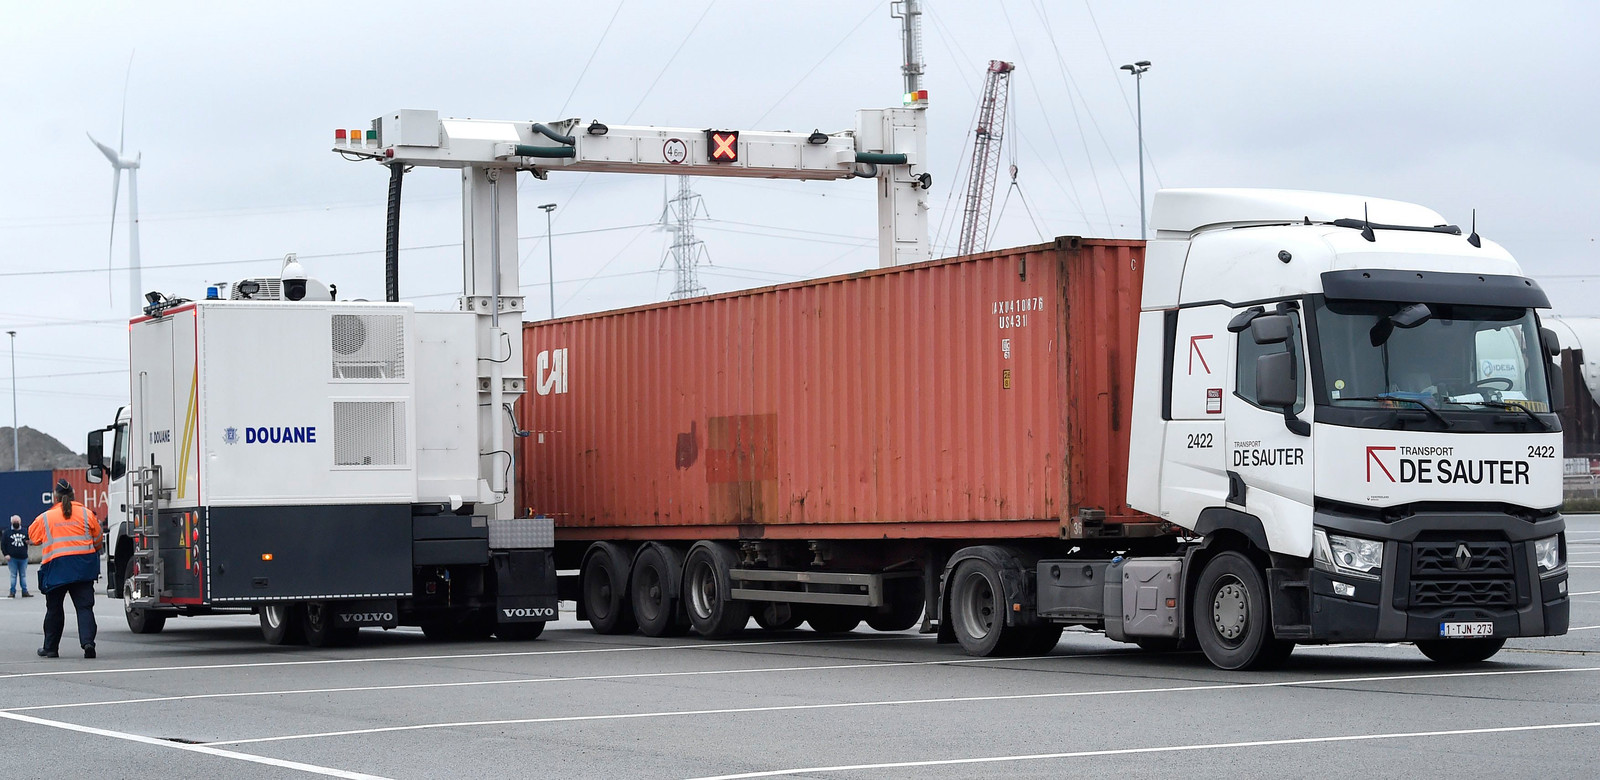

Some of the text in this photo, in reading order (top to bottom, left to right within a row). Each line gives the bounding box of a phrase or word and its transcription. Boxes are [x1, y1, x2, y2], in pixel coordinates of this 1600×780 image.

[536, 347, 568, 396] CAI
[153, 429, 171, 444] DOUANE
[245, 426, 317, 444] DOUANE
[1187, 432, 1213, 449] 2422
[1234, 440, 1261, 448] TRANSPORT
[1400, 446, 1454, 456] TRANSPORT
[1233, 448, 1304, 467] DE SAUTER
[1527, 445, 1555, 459] 2422
[1399, 458, 1530, 485] DE SAUTER
[340, 612, 393, 622] VOLVO
[502, 607, 554, 617] VOLVO
